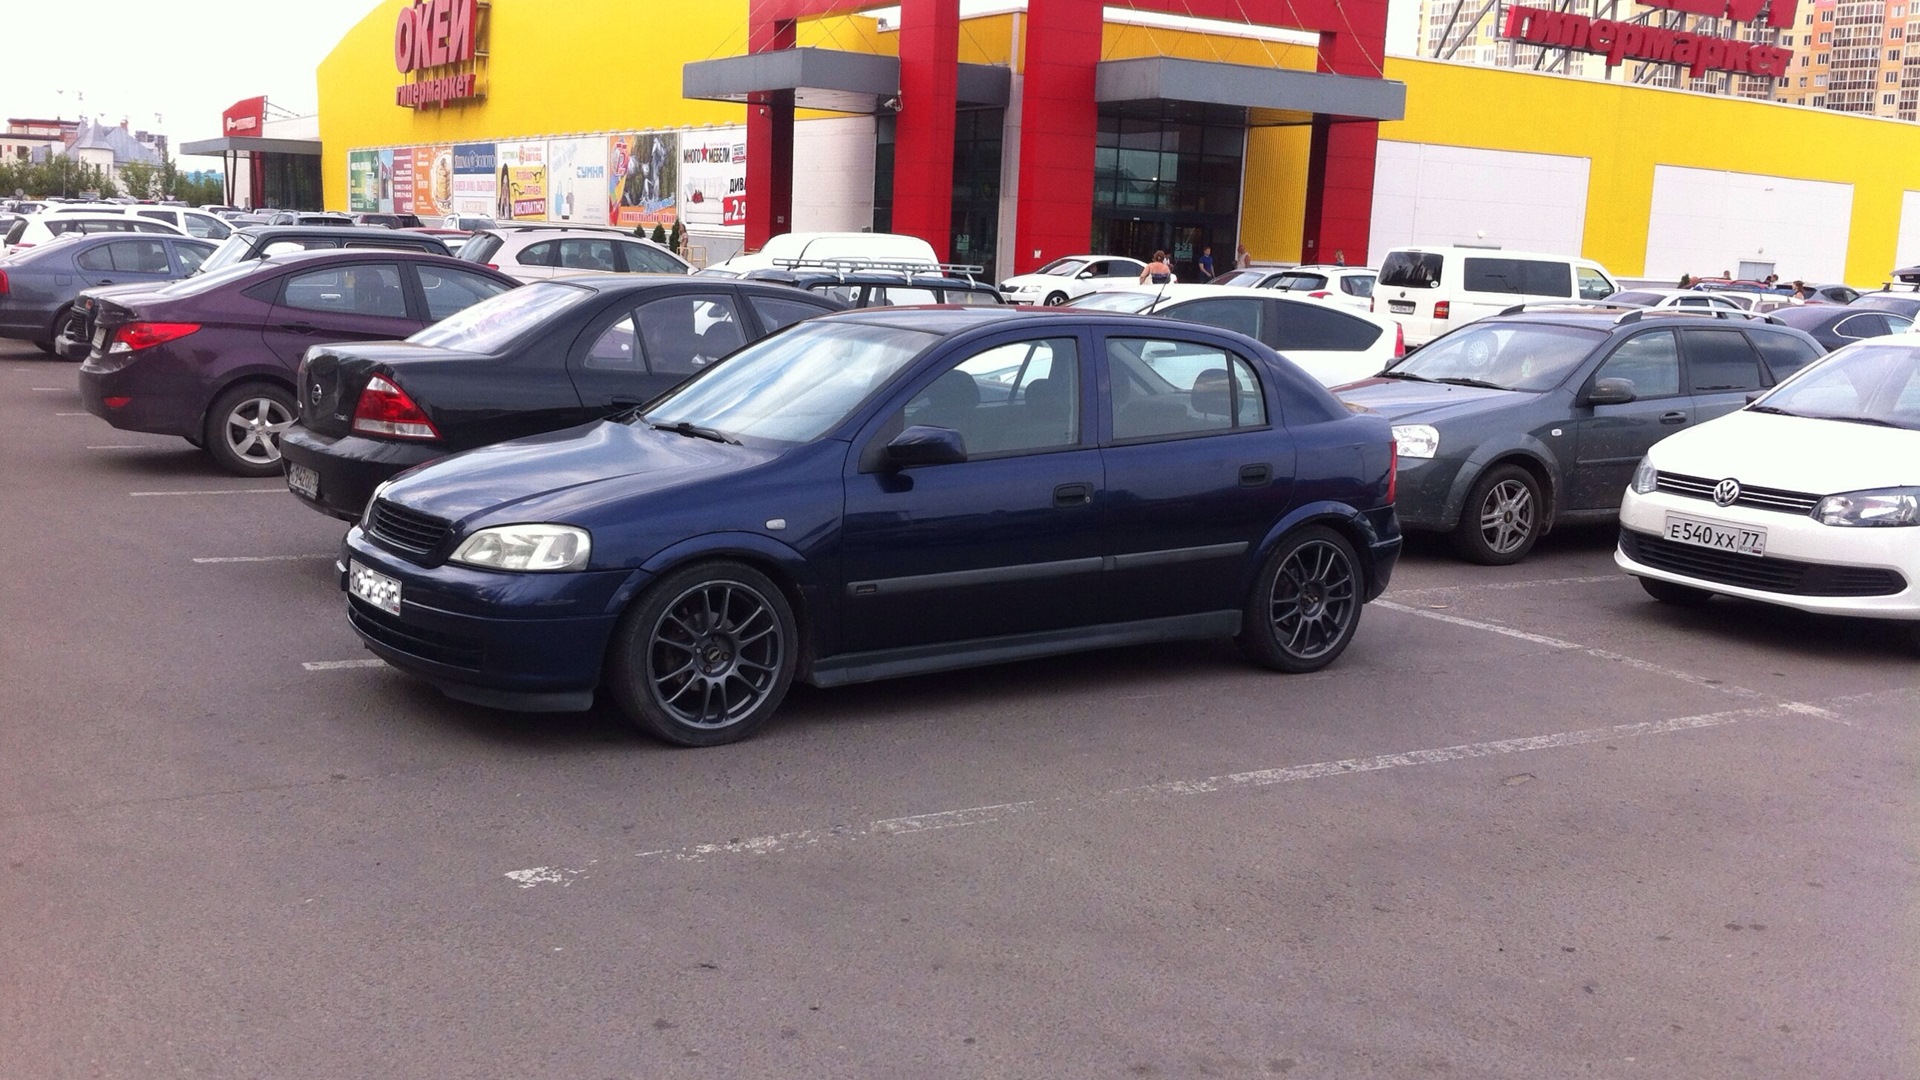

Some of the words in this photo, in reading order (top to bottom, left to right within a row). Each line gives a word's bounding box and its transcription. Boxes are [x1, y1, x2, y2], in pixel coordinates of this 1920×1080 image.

[1503, 5, 1794, 78] гипермаркет
[396, 74, 476, 111] гипермаркет
[683, 148, 701, 163] МНОГО
[708, 147, 730, 163] МЕБЕЛИ
[1741, 531, 1760, 547] 77
